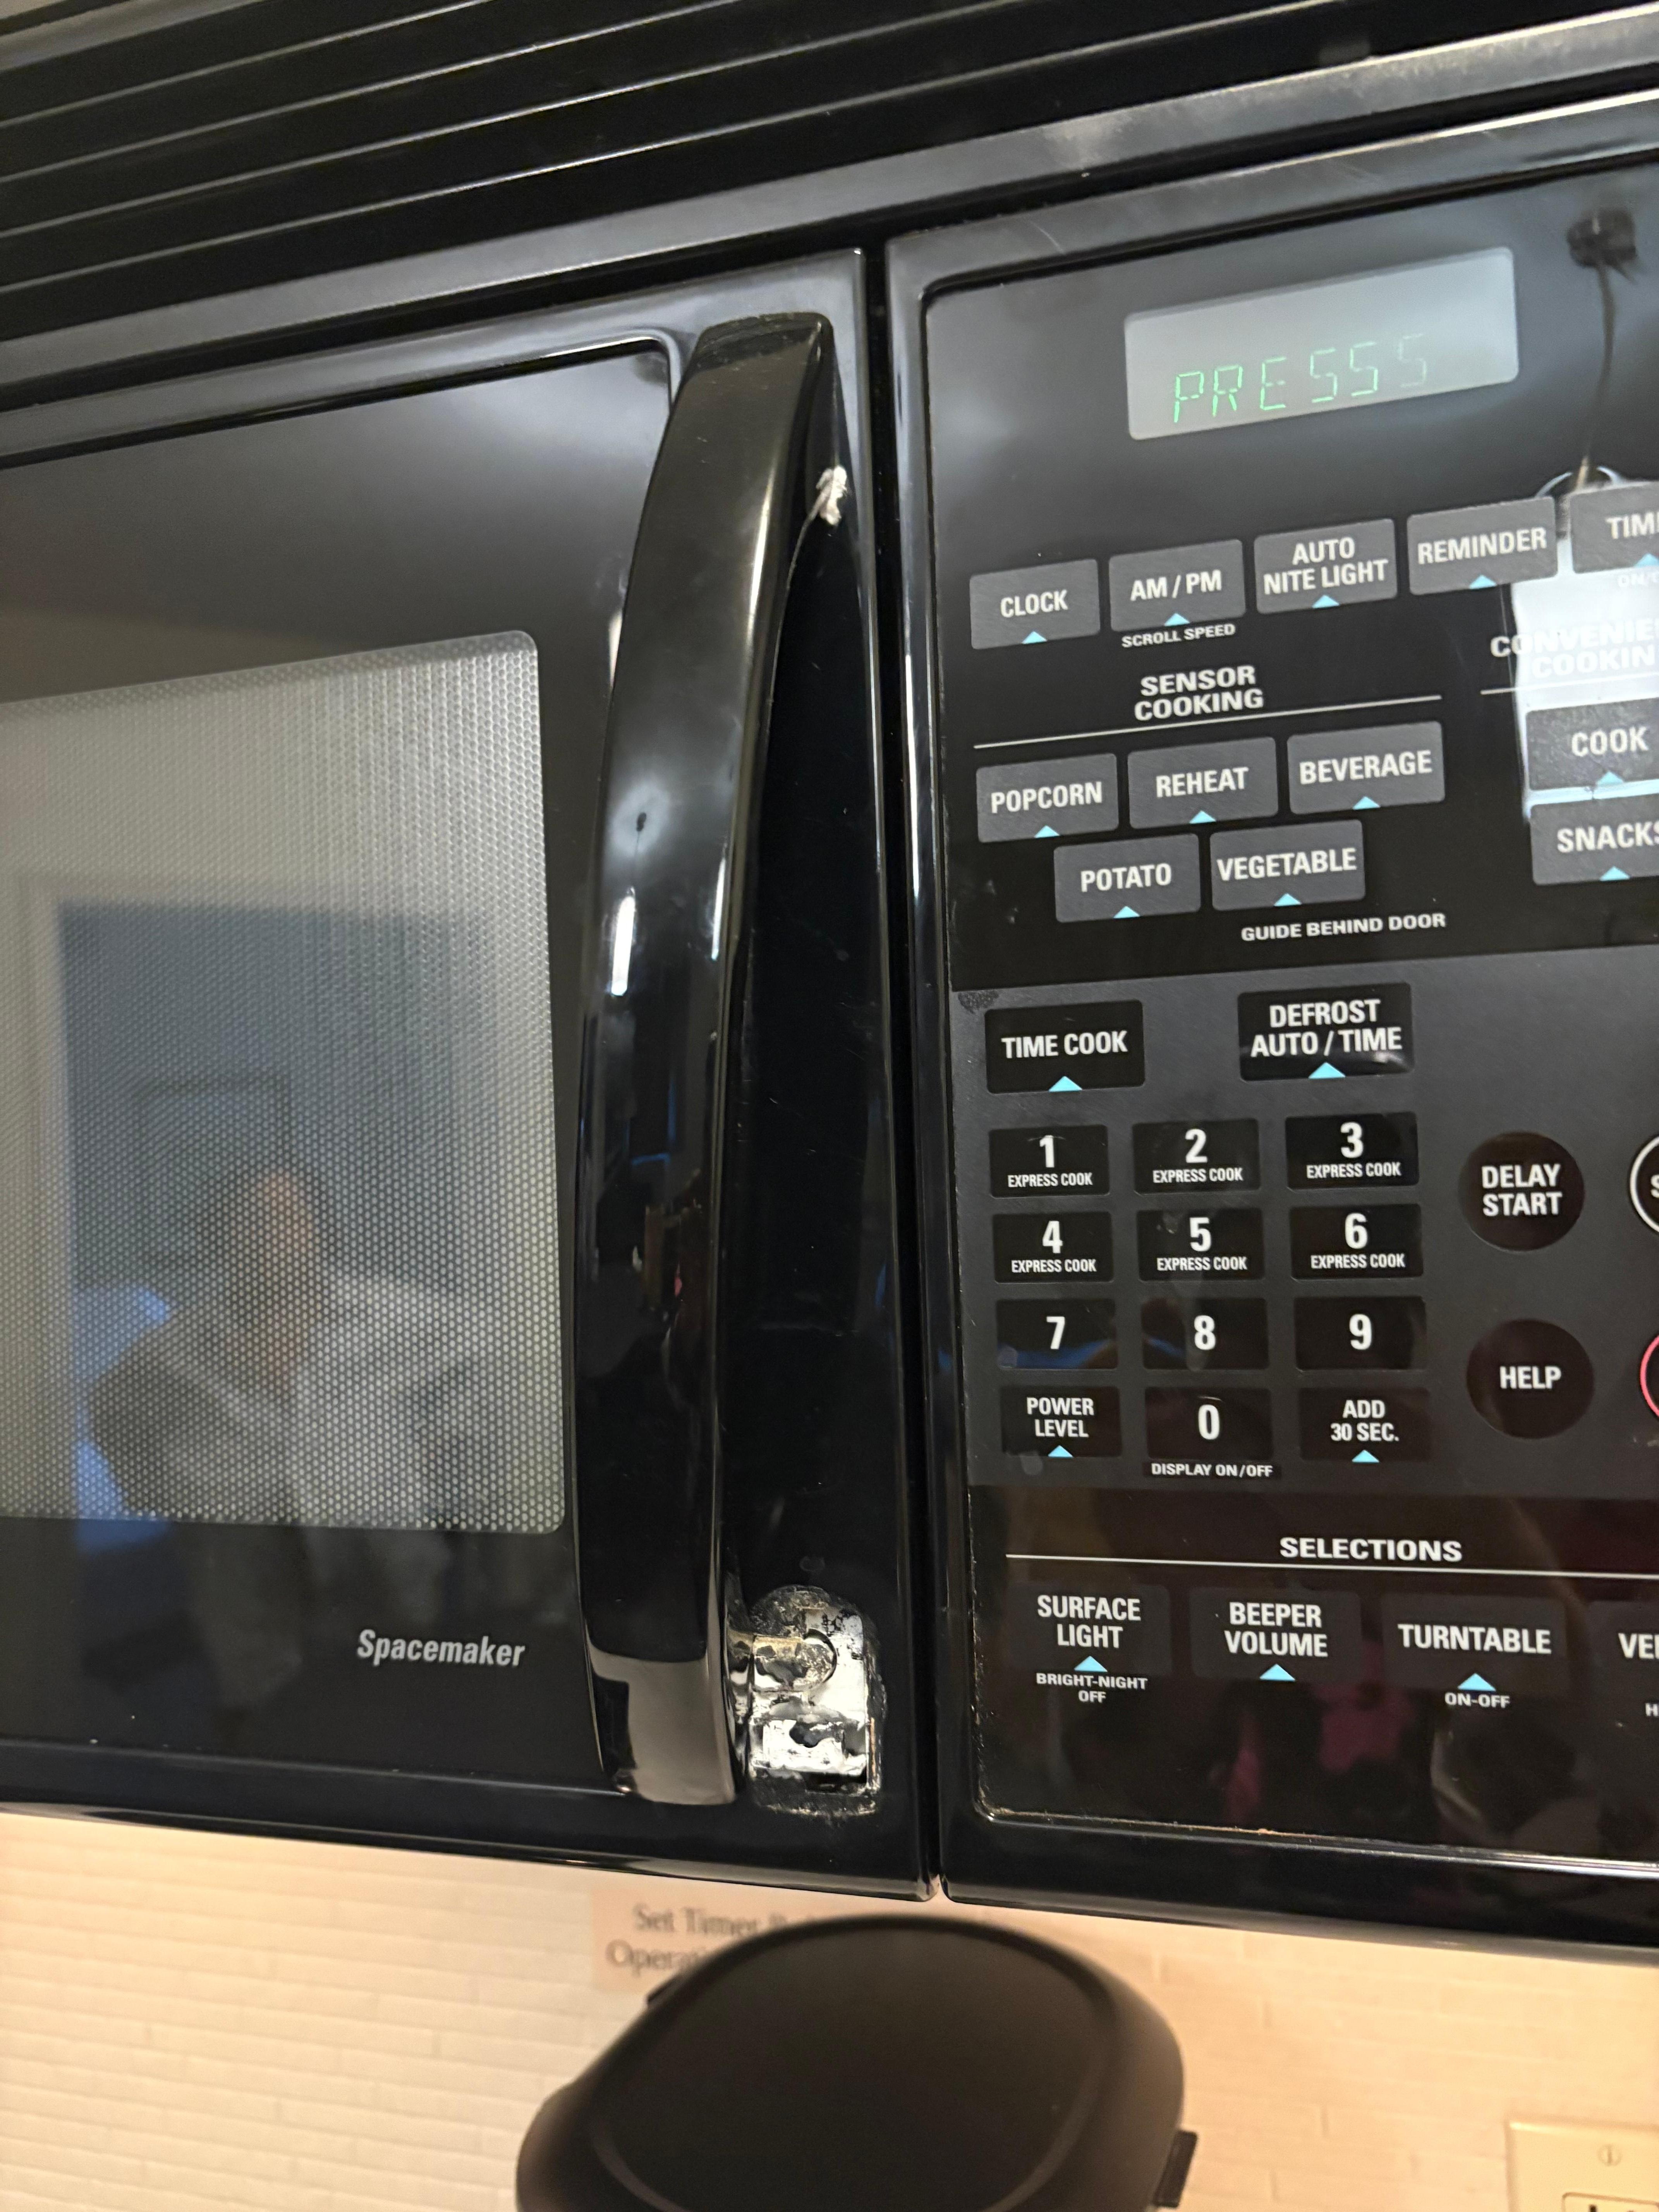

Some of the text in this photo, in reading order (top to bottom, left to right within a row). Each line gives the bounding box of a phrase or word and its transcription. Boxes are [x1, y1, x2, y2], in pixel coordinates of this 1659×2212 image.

[1605, 510, 1659, 540] TIM
[1291, 536, 1356, 566] AUTO
[1417, 527, 1547, 565] REMINDER
[1130, 576, 1168, 601] AM
[1185, 569, 1222, 594] PM
[1263, 558, 1389, 595] NITE LIGHT
[1000, 589, 1068, 618] CLOCK
[1121, 623, 1236, 648] SCROLL SPEED
[1490, 618, 1659, 658] CONVENIE
[1140, 665, 1256, 696] SENSOR
[1134, 689, 1264, 721] COOKING
[1571, 725, 1650, 758] COOK
[1156, 766, 1249, 798] REHEAT
[1299, 749, 1433, 785] BEVERAGE
[991, 781, 1103, 814] POPCORN
[1080, 862, 1172, 893] POTATO
[1216, 847, 1357, 881] VEGETABLE
[1241, 912, 1446, 941] GUIDE BEHIND DOOR
[1269, 998, 1381, 1028] DEFROST
[1001, 1030, 1128, 1059] TIME COOK
[1250, 1031, 1319, 1058] AUTO
[1337, 1026, 1402, 1053] TIME
[1039, 1135, 1055, 1168] 1
[1185, 1128, 1208, 1163] 2
[1340, 1121, 1364, 1159] 3
[1007, 1172, 1093, 1188] EXPRESS COOK
[1152, 1167, 1243, 1183] EXPRESS COOK
[1306, 1161, 1401, 1179] EXPRESS COOK
[1482, 1163, 1561, 1189] DELAY
[1482, 1192, 1563, 1217] START
[1042, 1220, 1063, 1254] 4
[1189, 1217, 1211, 1252] 5
[1345, 1212, 1368, 1249] 6
[1011, 1259, 1097, 1273] EXPRESS COOK
[1157, 1256, 1247, 1271] EXPRESS COOK
[1310, 1253, 1405, 1269] EXPRESS COOK
[1046, 1316, 1065, 1350] 7
[1194, 1315, 1216, 1350] 8
[1349, 1314, 1372, 1350] 9
[1499, 1366, 1562, 1389] HELP
[1026, 1397, 1094, 1416] POWER
[1342, 1400, 1386, 1419] ADD
[1034, 1419, 1089, 1438] LEVEL
[1197, 1403, 1221, 1441] 0
[1330, 1422, 1399, 1442] 30 SEC.
[1151, 1463, 1273, 1478] DISPLAY ON/OFF
[1279, 1537, 1462, 1562] SELECTIONS
[1037, 1594, 1141, 1621] SURFACE
[1229, 1602, 1322, 1628] BEEPER
[357, 1629, 526, 1666] Spacemaker
[1057, 1623, 1123, 1649] LIGHT
[1224, 1630, 1328, 1657] VOLUME
[1397, 1623, 1552, 1654] TURNTABLE
[1618, 1633, 1659, 1659] VE
[1036, 1672, 1148, 1690] BRIGHT-NIGHT
[1078, 1690, 1106, 1703] OFF
[1444, 1692, 1510, 1708] ON-OFF
